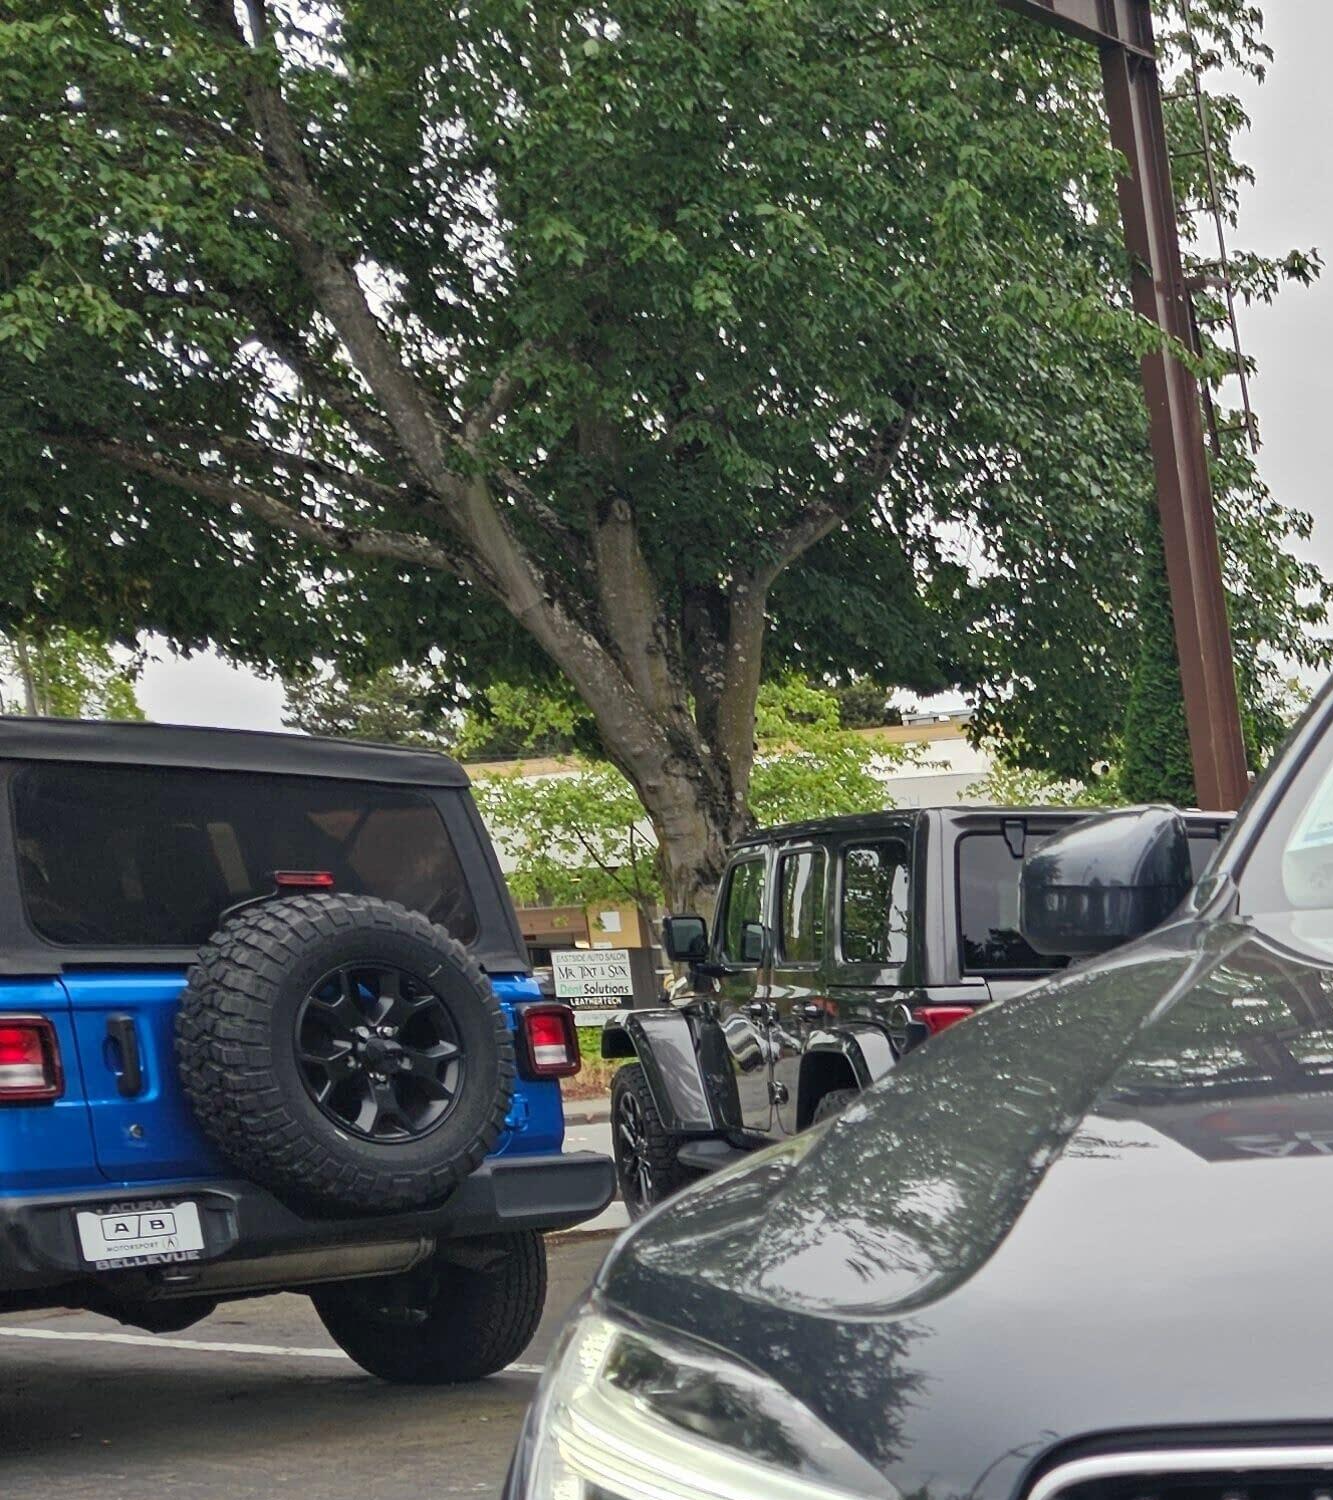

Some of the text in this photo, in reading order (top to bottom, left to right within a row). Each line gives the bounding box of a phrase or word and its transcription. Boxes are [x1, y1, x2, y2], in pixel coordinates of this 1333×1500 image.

[587, 953, 604, 962] AUTO
[605, 952, 627, 961] SALON
[584, 981, 629, 994] Solutions
[108, 1201, 166, 1214] ACURA
[106, 1241, 159, 1252] MOTORSPORT
[95, 1251, 201, 1270] BELLEVUE
